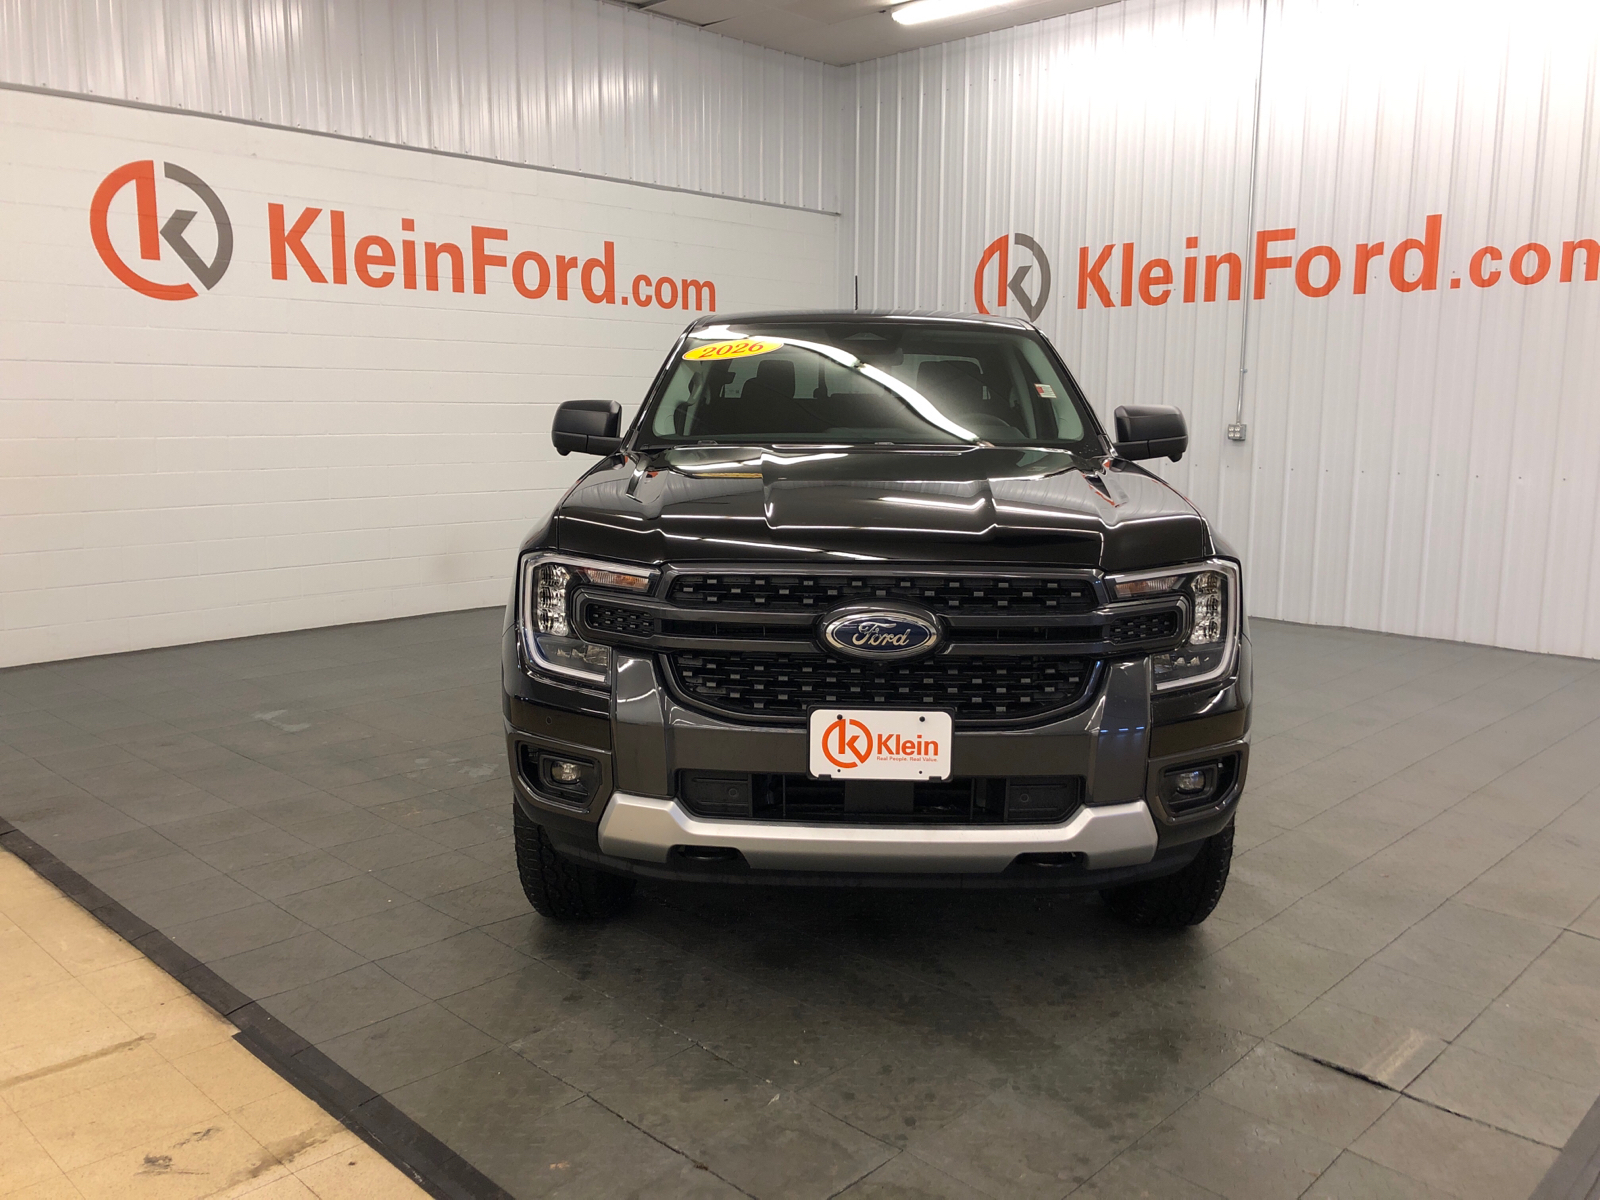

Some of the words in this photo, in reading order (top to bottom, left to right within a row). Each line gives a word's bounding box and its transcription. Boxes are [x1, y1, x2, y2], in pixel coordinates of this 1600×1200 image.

[268, 203, 717, 312] KleinFord.com
[1077, 214, 1600, 309] KleinFord.com
[698, 341, 764, 358] 2026
[852, 621, 911, 646] Ford
[877, 733, 939, 756] Klein
